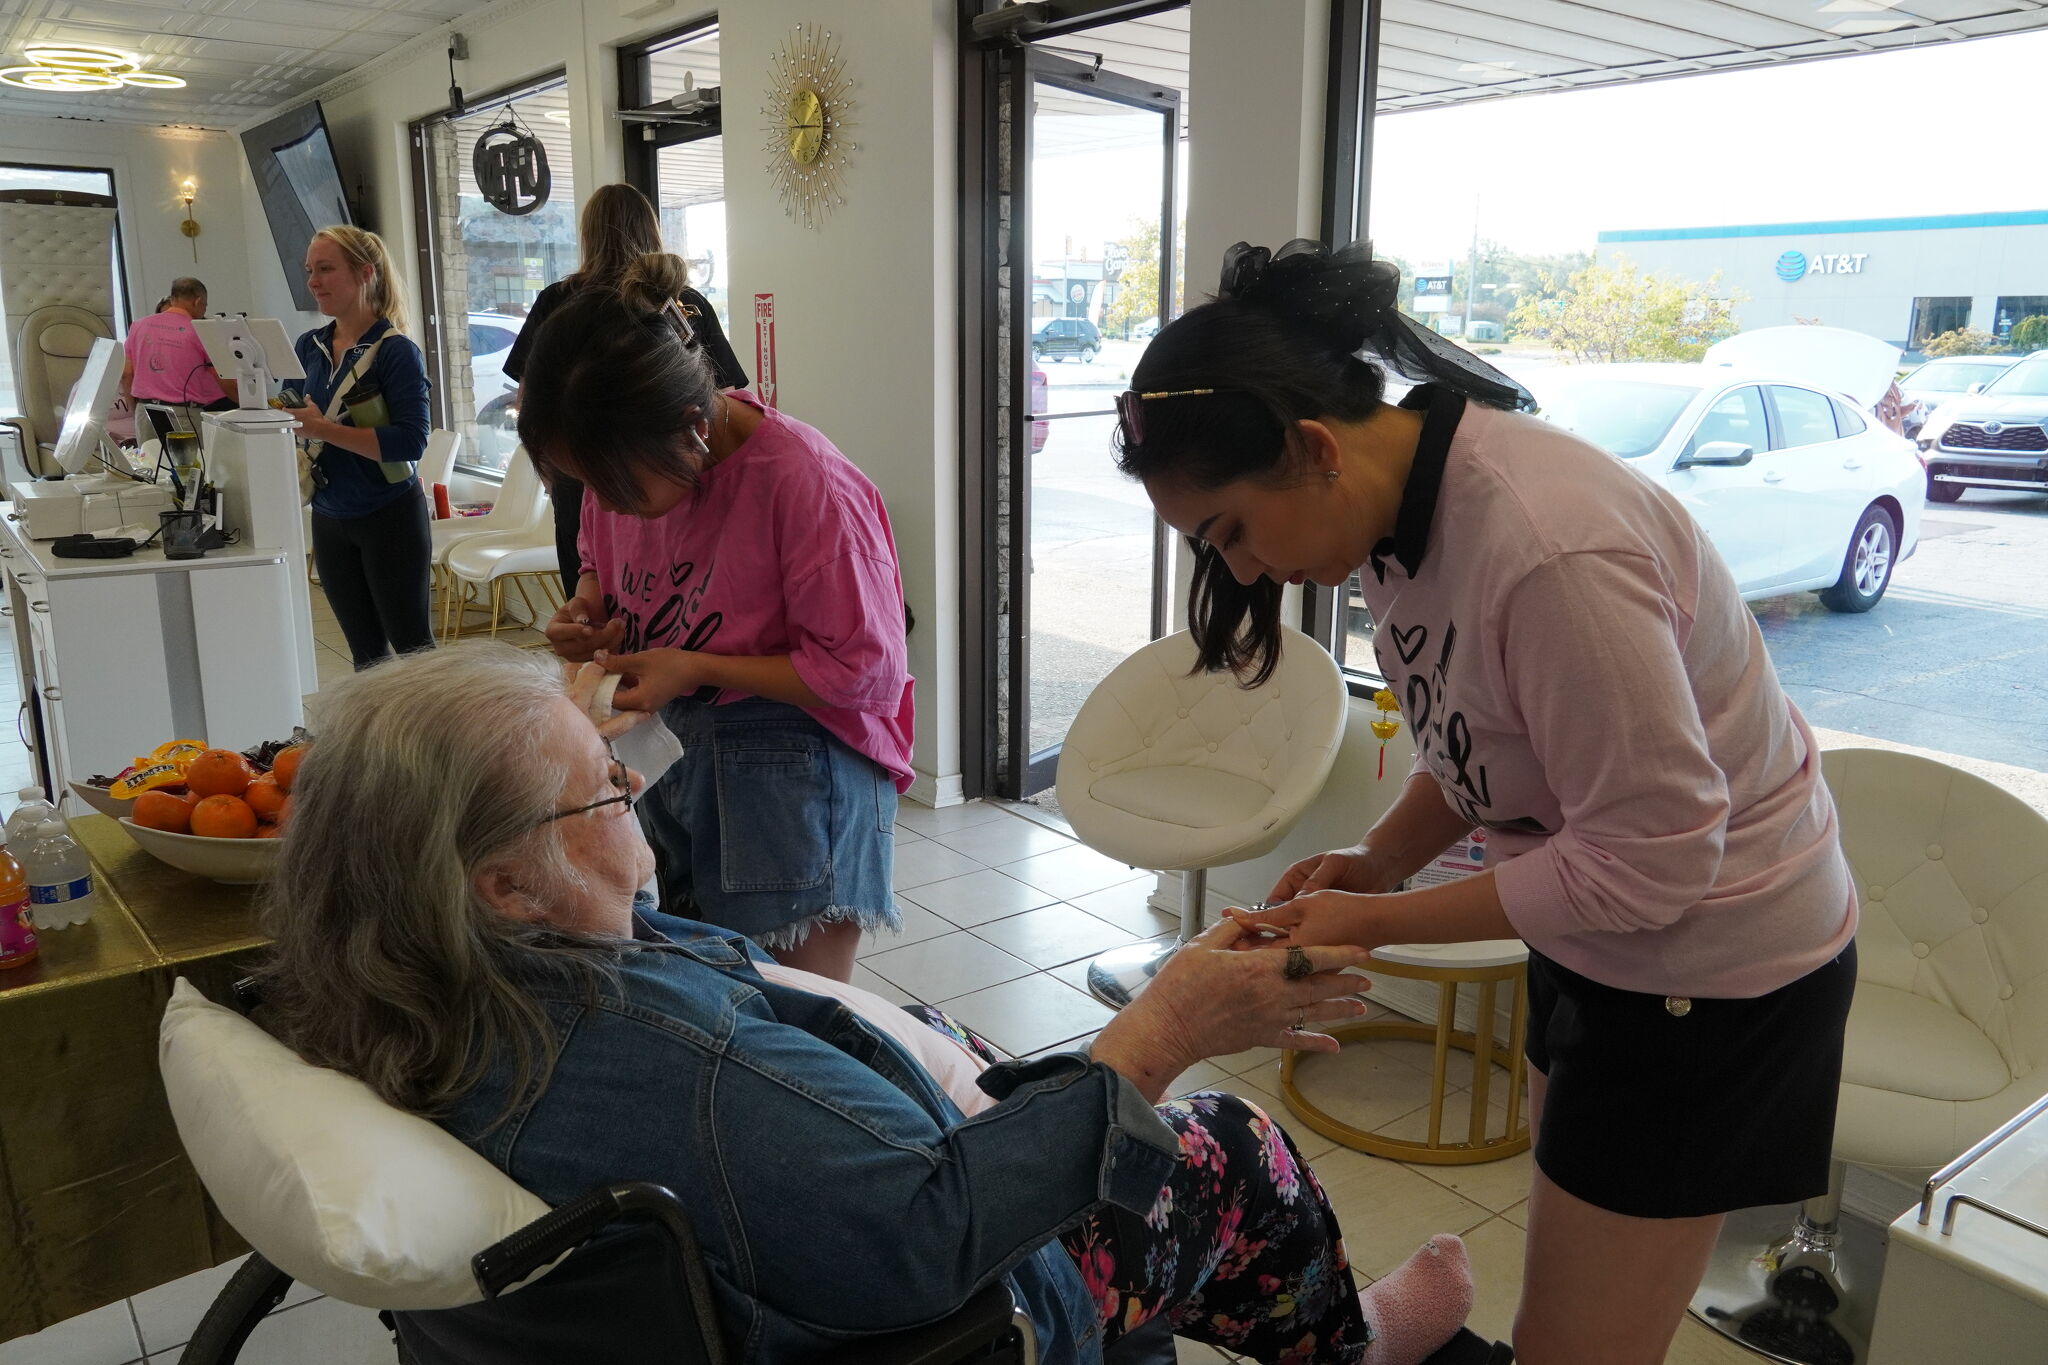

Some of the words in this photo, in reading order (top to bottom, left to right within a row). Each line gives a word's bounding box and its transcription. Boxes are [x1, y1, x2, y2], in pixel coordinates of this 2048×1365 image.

[800, 91, 806, 101] 12
[814, 103, 818, 113] 2
[816, 118, 821, 128] 3
[791, 140, 795, 149] 8
[796, 150, 800, 159] 7
[803, 151, 808, 161] 6
[811, 146, 815, 156] 5
[1808, 253, 1867, 274] AT&T
[1427, 280, 1447, 290] AT&T
[757, 303, 772, 318] FIRE
[621, 562, 656, 602] WE
